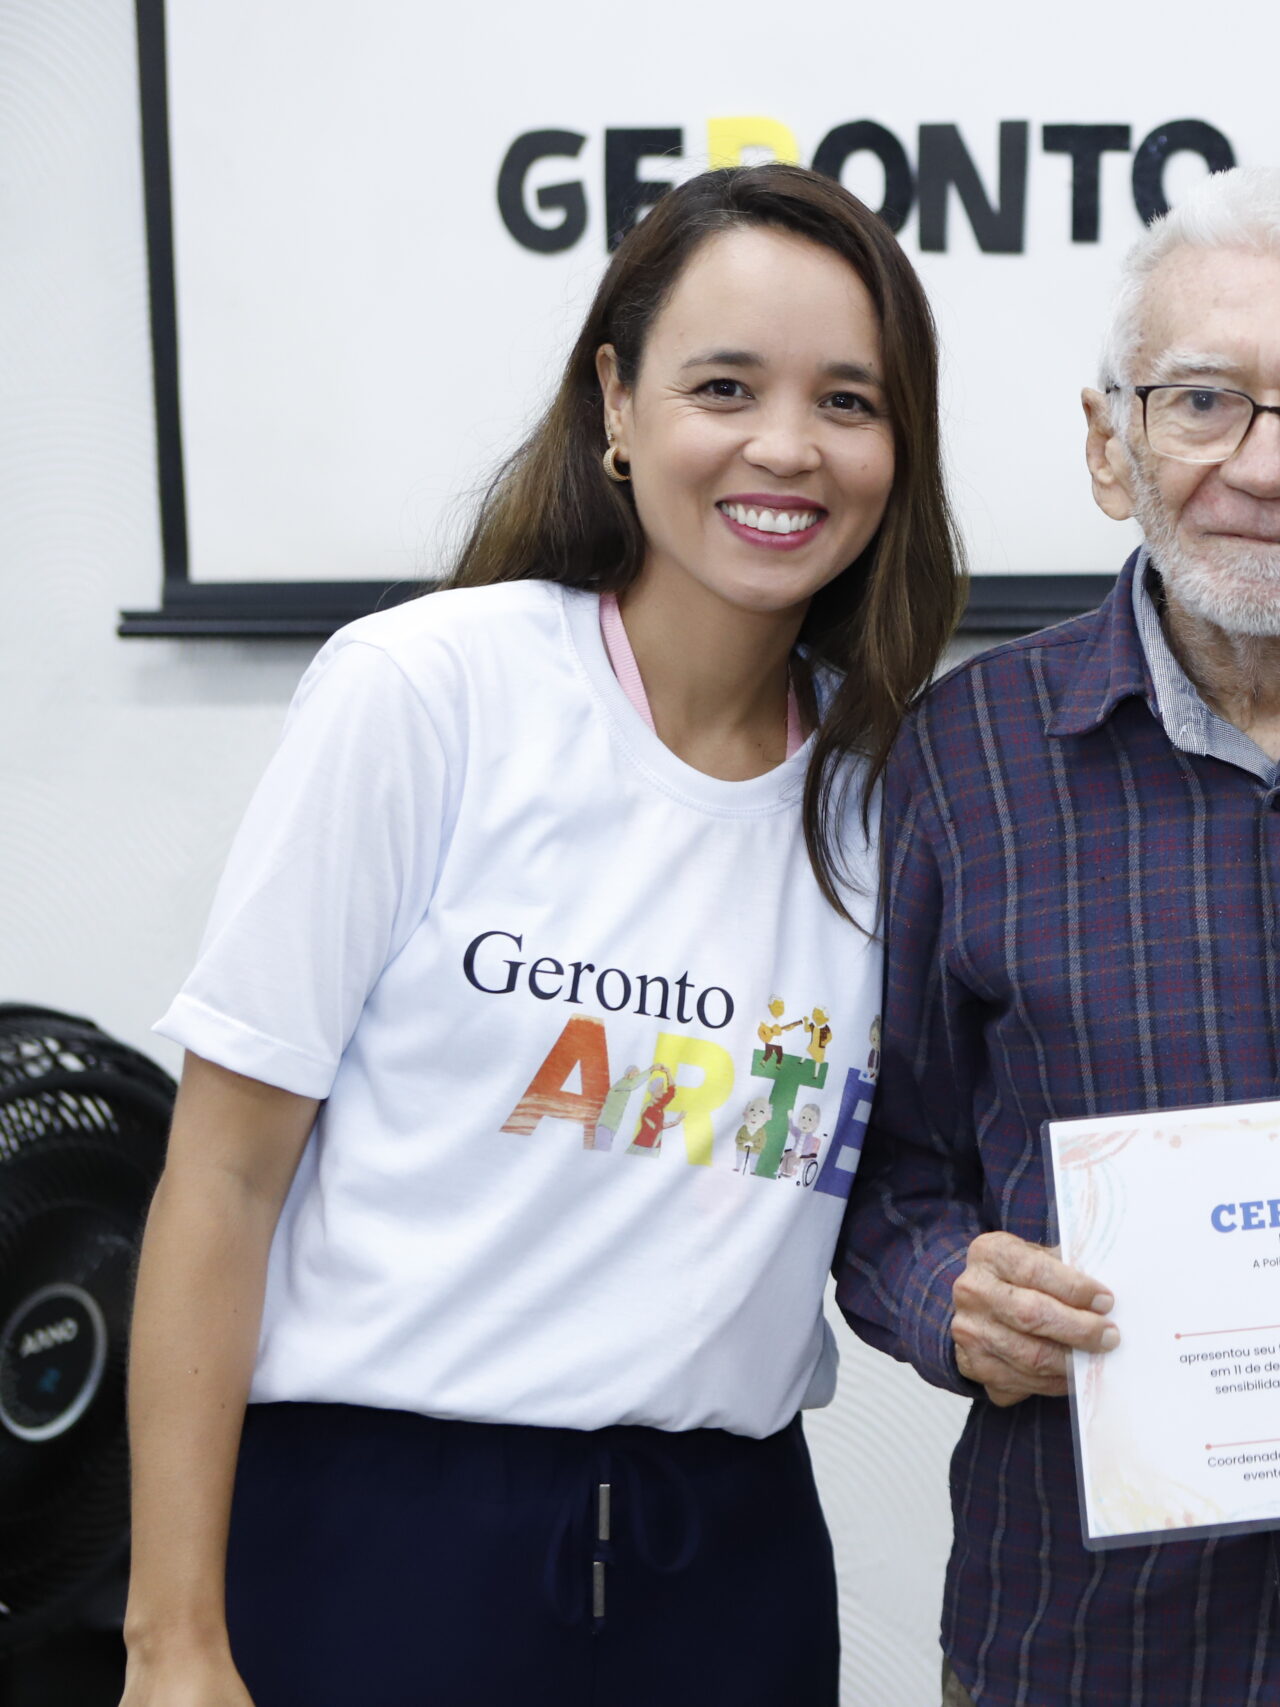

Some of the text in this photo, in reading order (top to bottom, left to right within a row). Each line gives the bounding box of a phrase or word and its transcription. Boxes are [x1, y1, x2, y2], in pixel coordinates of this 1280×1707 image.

[463, 930, 735, 1029] Geronto
[1252, 1258, 1261, 1268] A
[1179, 1347, 1250, 1365] apresentou
[1253, 1345, 1275, 1356] seu
[1210, 1367, 1231, 1378] em
[1234, 1364, 1242, 1375] 11
[1245, 1362, 1261, 1374] de
